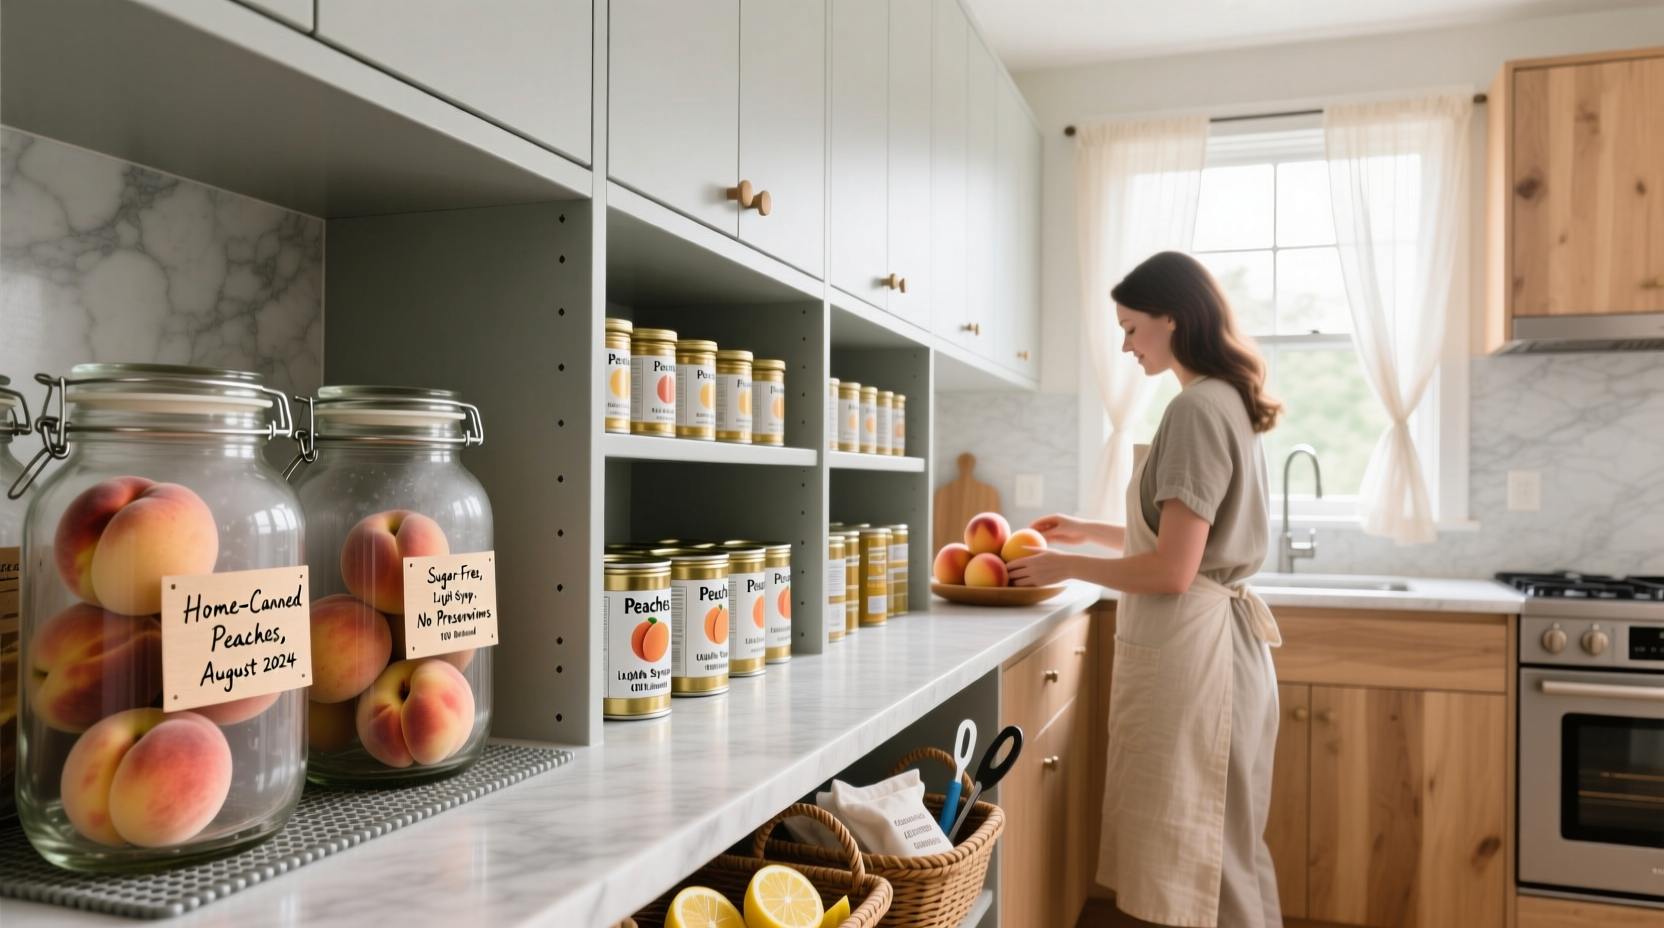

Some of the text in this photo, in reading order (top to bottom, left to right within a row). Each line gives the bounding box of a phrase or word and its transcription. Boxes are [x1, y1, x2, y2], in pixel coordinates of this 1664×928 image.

[183, 584, 303, 624] Home-Canned
[417, 611, 432, 629] No
[211, 622, 286, 652] Peaches,
[200, 652, 297, 692] August 2024
